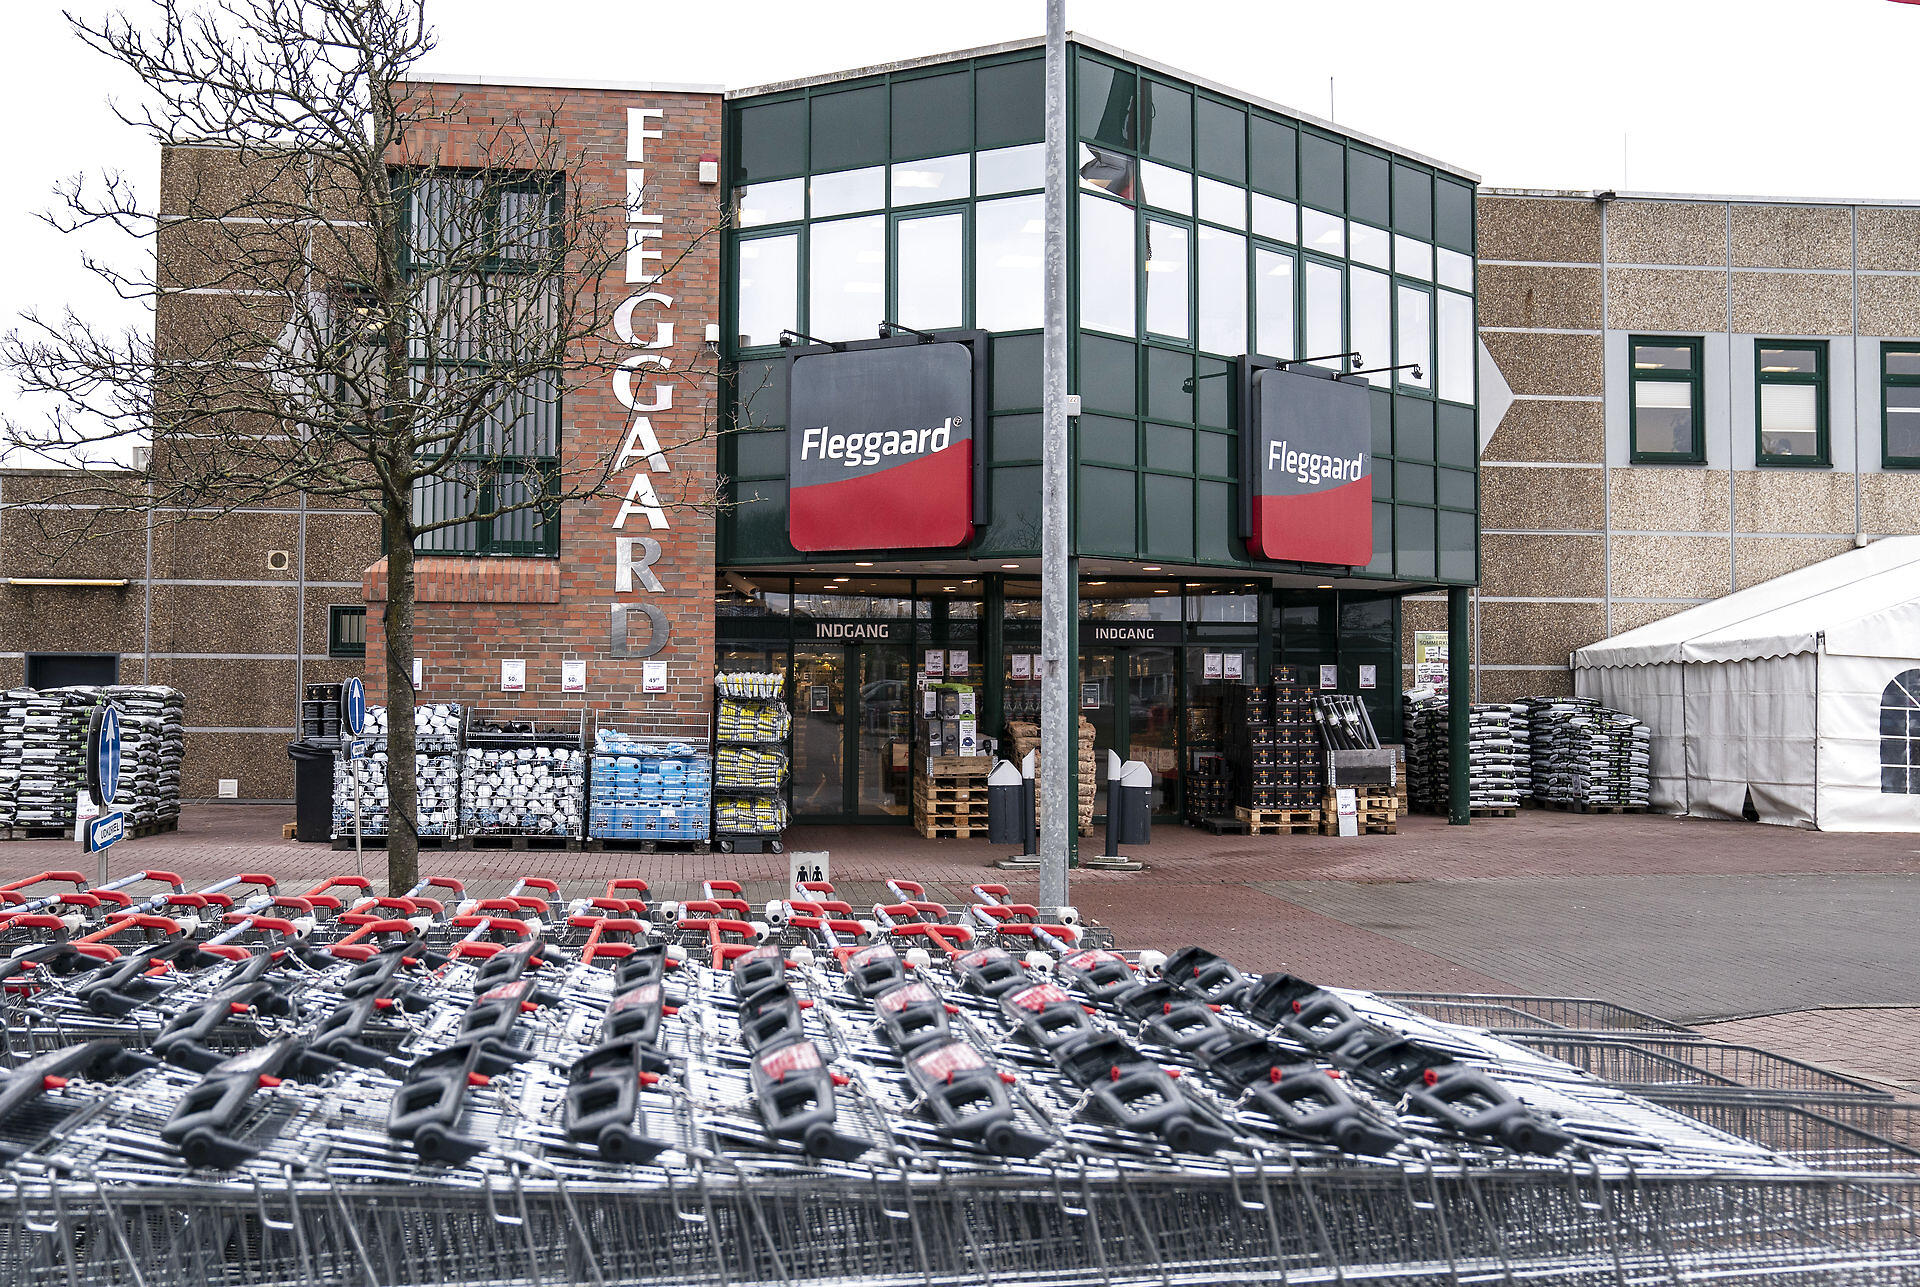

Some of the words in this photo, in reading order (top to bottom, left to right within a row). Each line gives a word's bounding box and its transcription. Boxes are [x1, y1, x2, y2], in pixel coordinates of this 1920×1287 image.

[610, 107, 675, 659] FLEGGAARD
[801, 417, 952, 467] Fleggaard
[1268, 440, 1363, 485] Fleggaard
[816, 623, 889, 639] INDGANG
[1095, 627, 1155, 640] INDGANG
